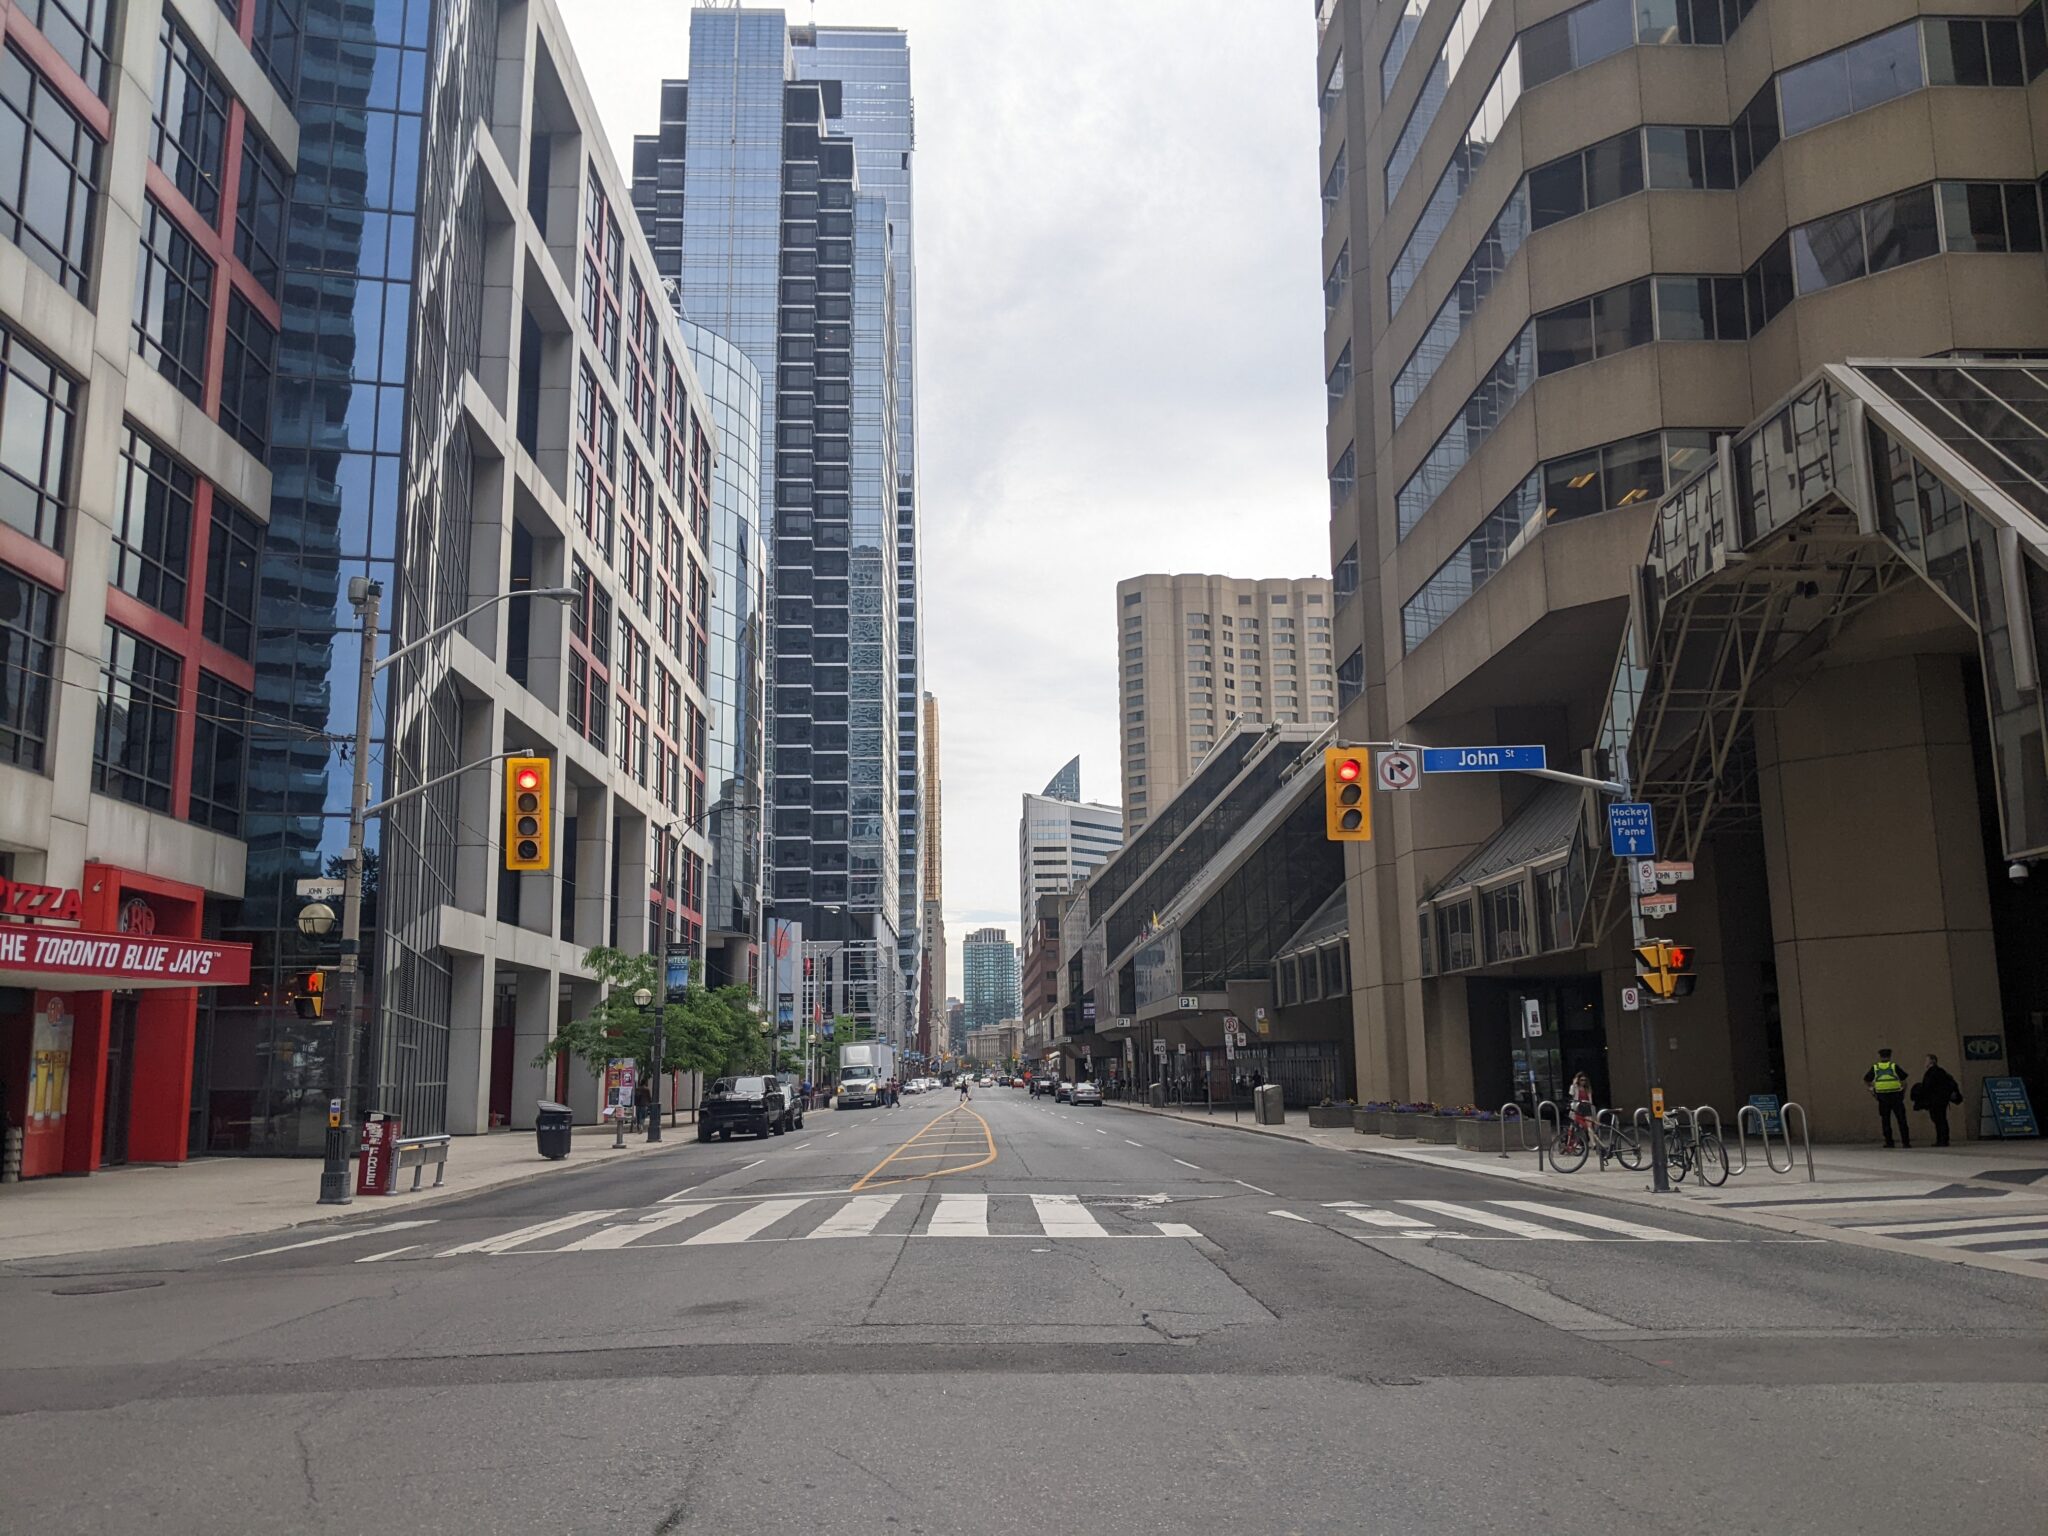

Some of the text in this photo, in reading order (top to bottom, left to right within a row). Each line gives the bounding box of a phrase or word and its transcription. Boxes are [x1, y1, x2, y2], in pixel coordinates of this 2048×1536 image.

[1458, 749, 1514, 766] John St
[1611, 808, 1648, 817] Hockey
[1613, 817, 1648, 826] Hall of
[1618, 828, 1645, 836] Fame
[307, 887, 322, 895] JOHN
[34, 937, 120, 967] TORONTO
[122, 945, 168, 971] BLUE
[1182, 999, 1188, 1007] P
[1155, 1045, 1165, 1053] 40
[365, 1147, 378, 1186] FREE
